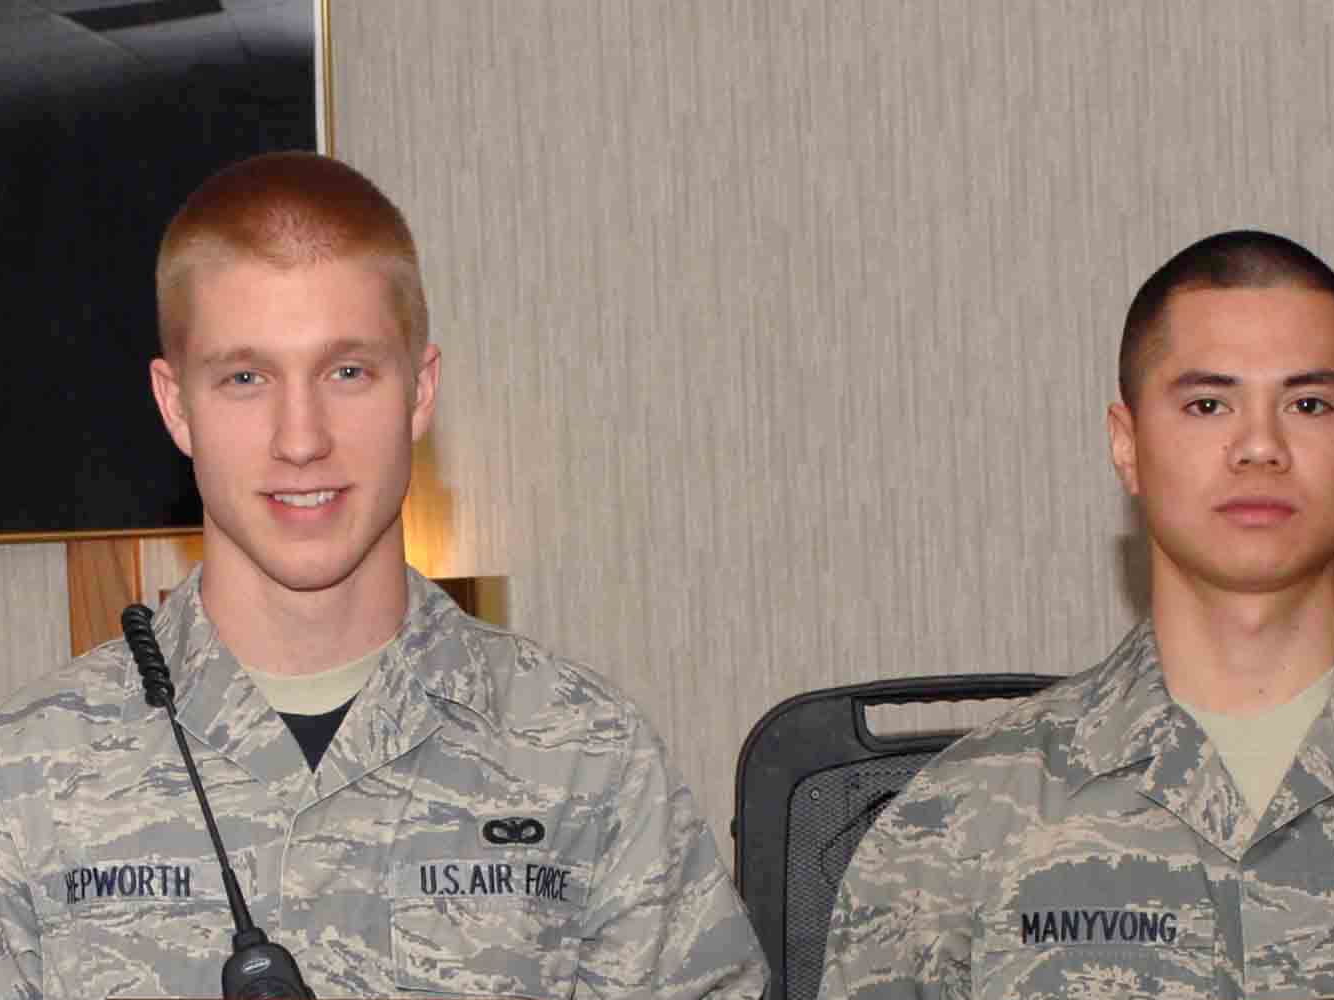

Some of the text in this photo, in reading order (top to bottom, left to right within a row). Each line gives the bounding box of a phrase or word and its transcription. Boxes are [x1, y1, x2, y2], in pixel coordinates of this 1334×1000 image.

[65, 865, 191, 904] HEPWORTH
[420, 864, 571, 901] U.S. AIR FORCE
[1021, 910, 1178, 944] MANYVONG
